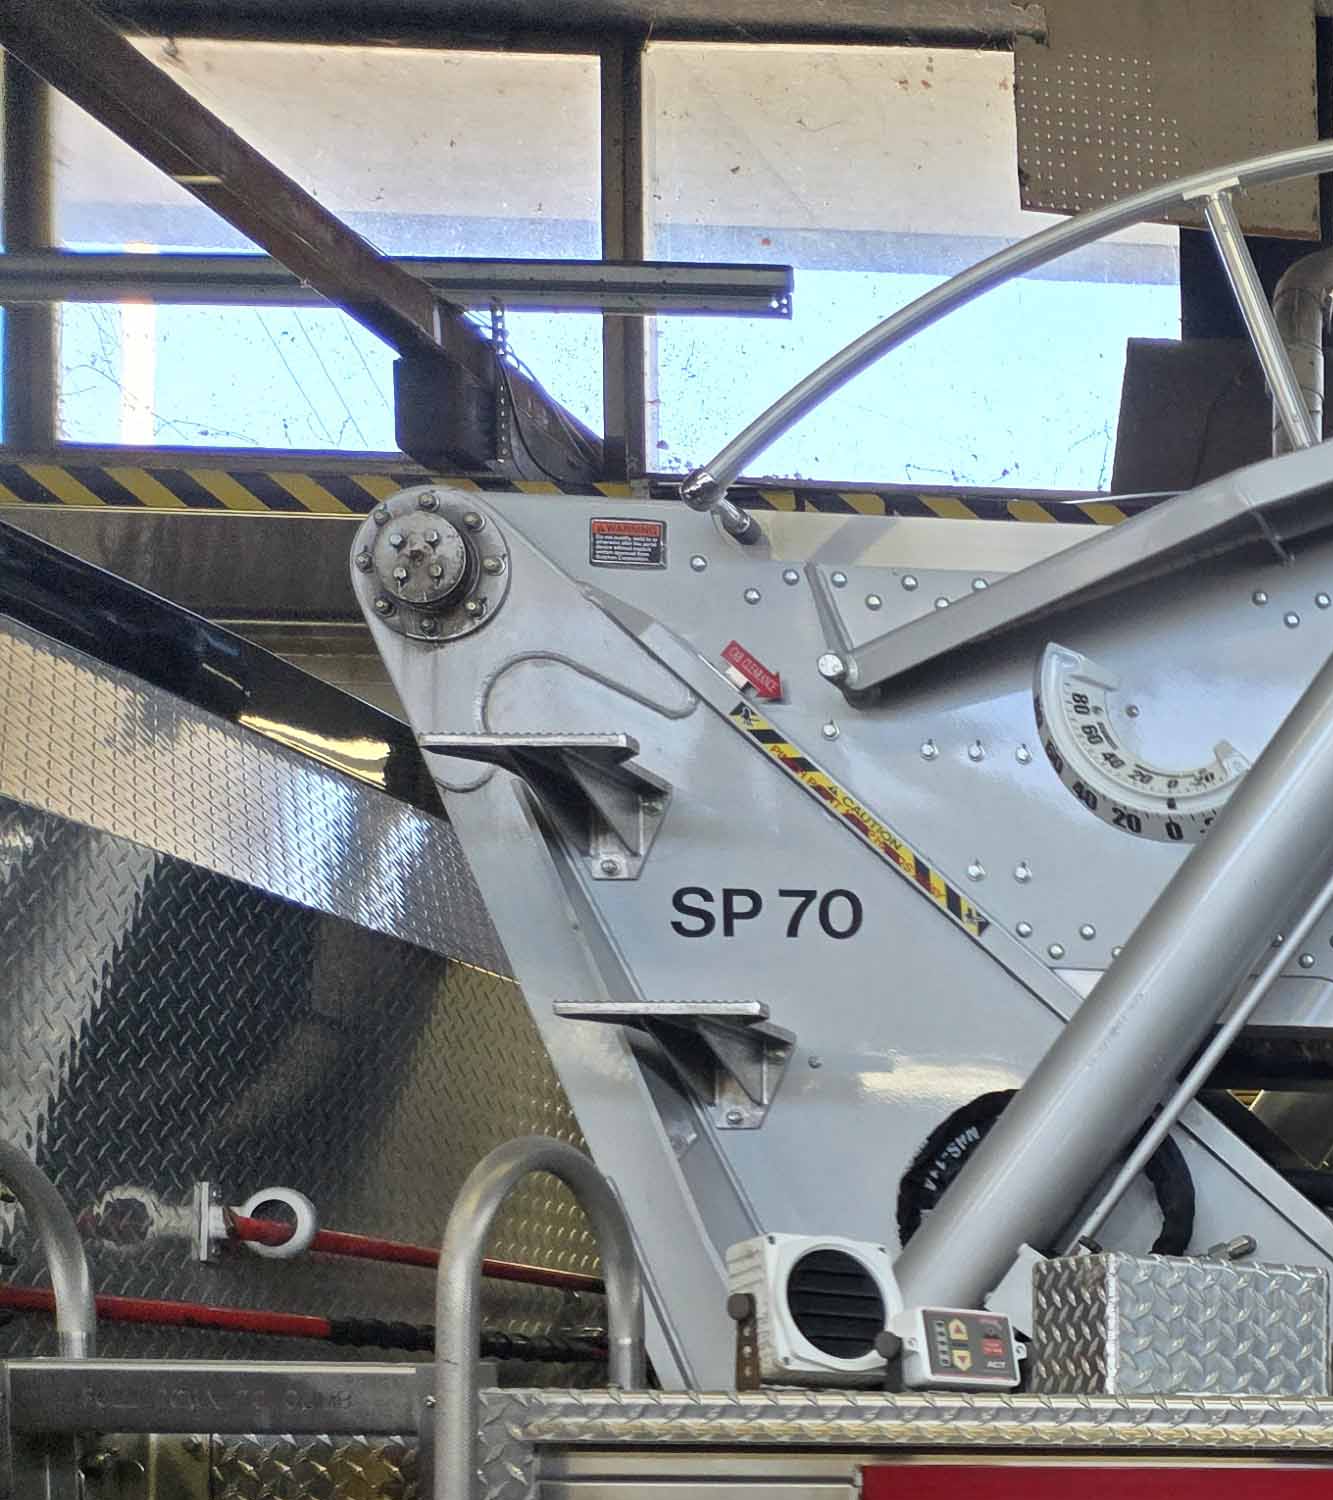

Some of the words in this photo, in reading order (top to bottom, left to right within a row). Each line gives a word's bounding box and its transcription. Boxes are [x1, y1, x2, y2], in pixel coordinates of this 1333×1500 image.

[607, 523, 658, 534] WARNING
[1071, 691, 1091, 715] 80
[1080, 723, 1104, 746] 60
[1101, 750, 1126, 769] 40
[1128, 769, 1154, 785] 20
[842, 795, 904, 851] CAUTION
[1111, 806, 1143, 834] 20
[1164, 821, 1184, 841] 0
[670, 886, 762, 938] SP
[778, 888, 864, 939] 70
